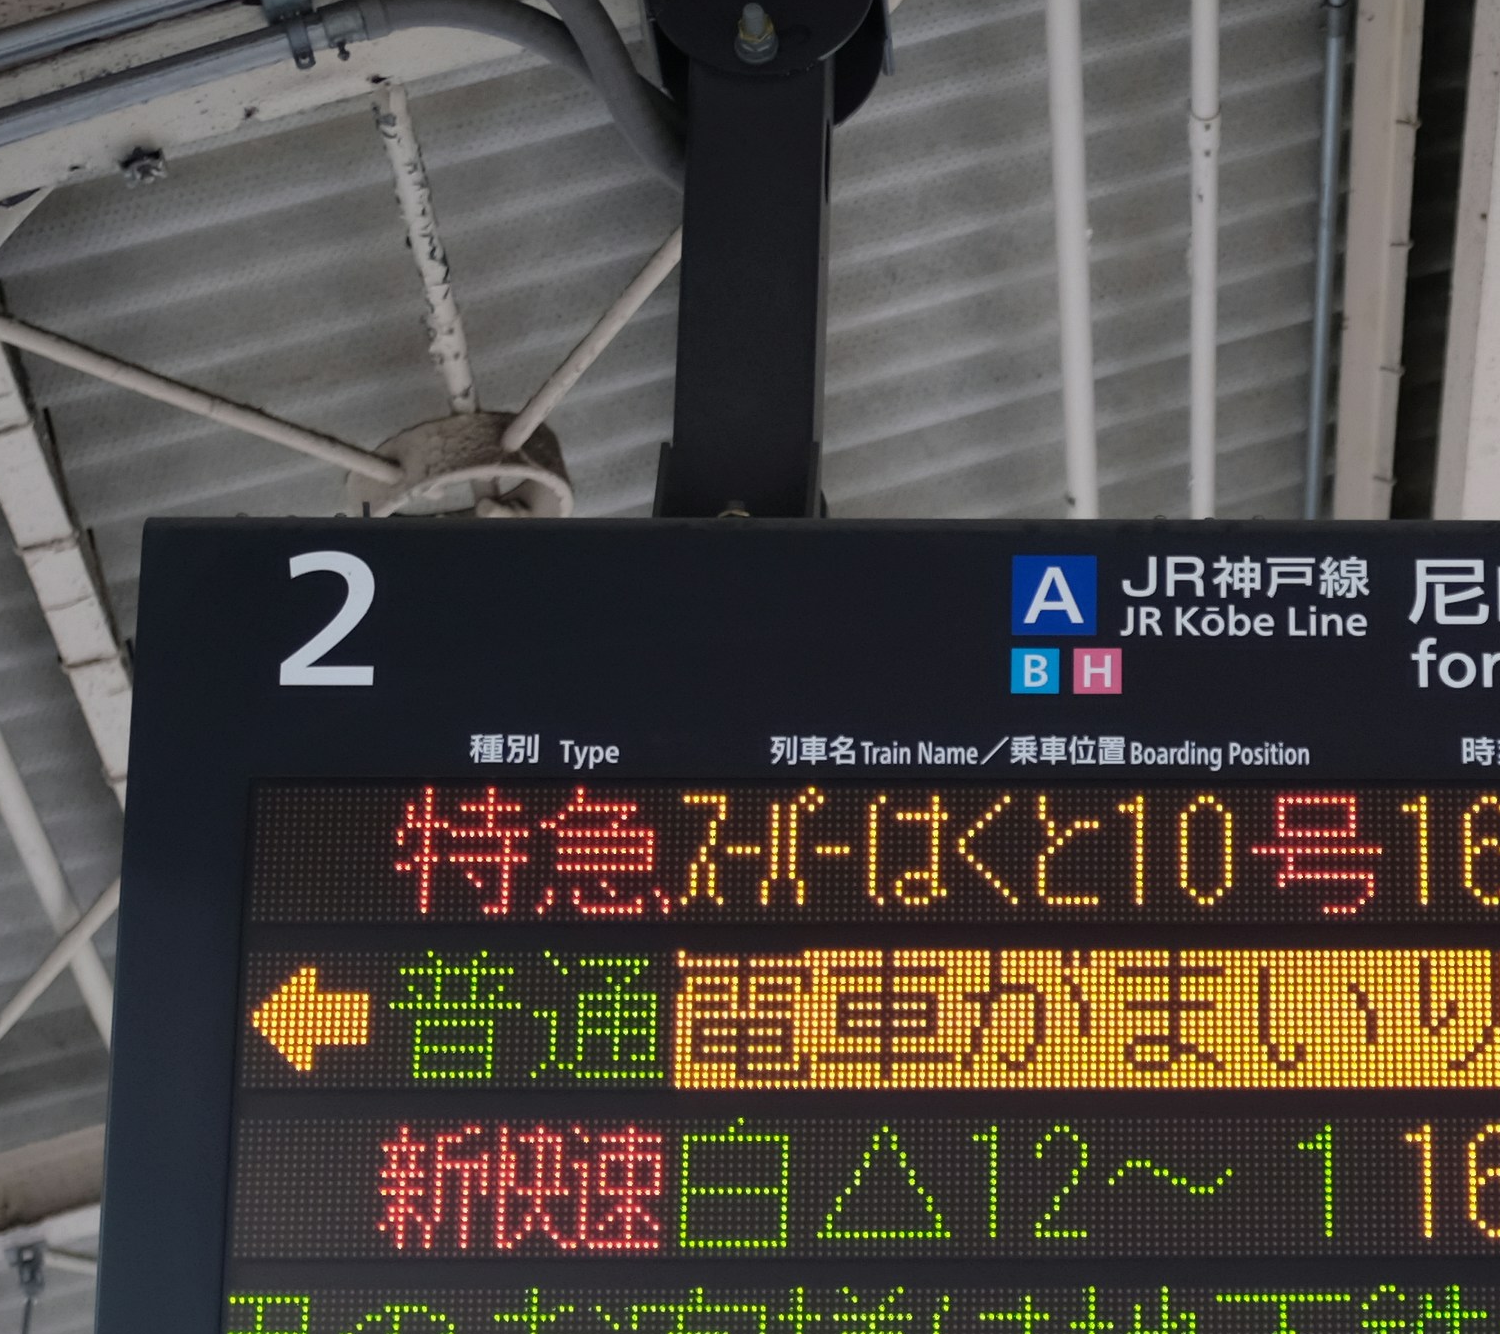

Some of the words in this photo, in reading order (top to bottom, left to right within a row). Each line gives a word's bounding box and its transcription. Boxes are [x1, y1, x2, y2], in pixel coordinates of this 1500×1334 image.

[1023, 566, 1084, 624] A
[1121, 555, 1370, 599] JR神戸線
[279, 550, 376, 686] 2
[1119, 606, 1163, 637] JR
[1175, 604, 1275, 637] Kōbe
[1288, 605, 1368, 637] Line
[1024, 654, 1048, 688] B
[1081, 653, 1114, 689] H
[469, 733, 540, 764] 種別
[559, 739, 620, 770] Type
[770, 735, 856, 766] 列車名
[860, 740, 912, 765] Train
[1130, 740, 1223, 772] Boarding
[1228, 741, 1310, 766] Position
[394, 786, 670, 915] 特急
[388, 950, 664, 1079] 普通
[377, 1125, 663, 1250] 新快速
